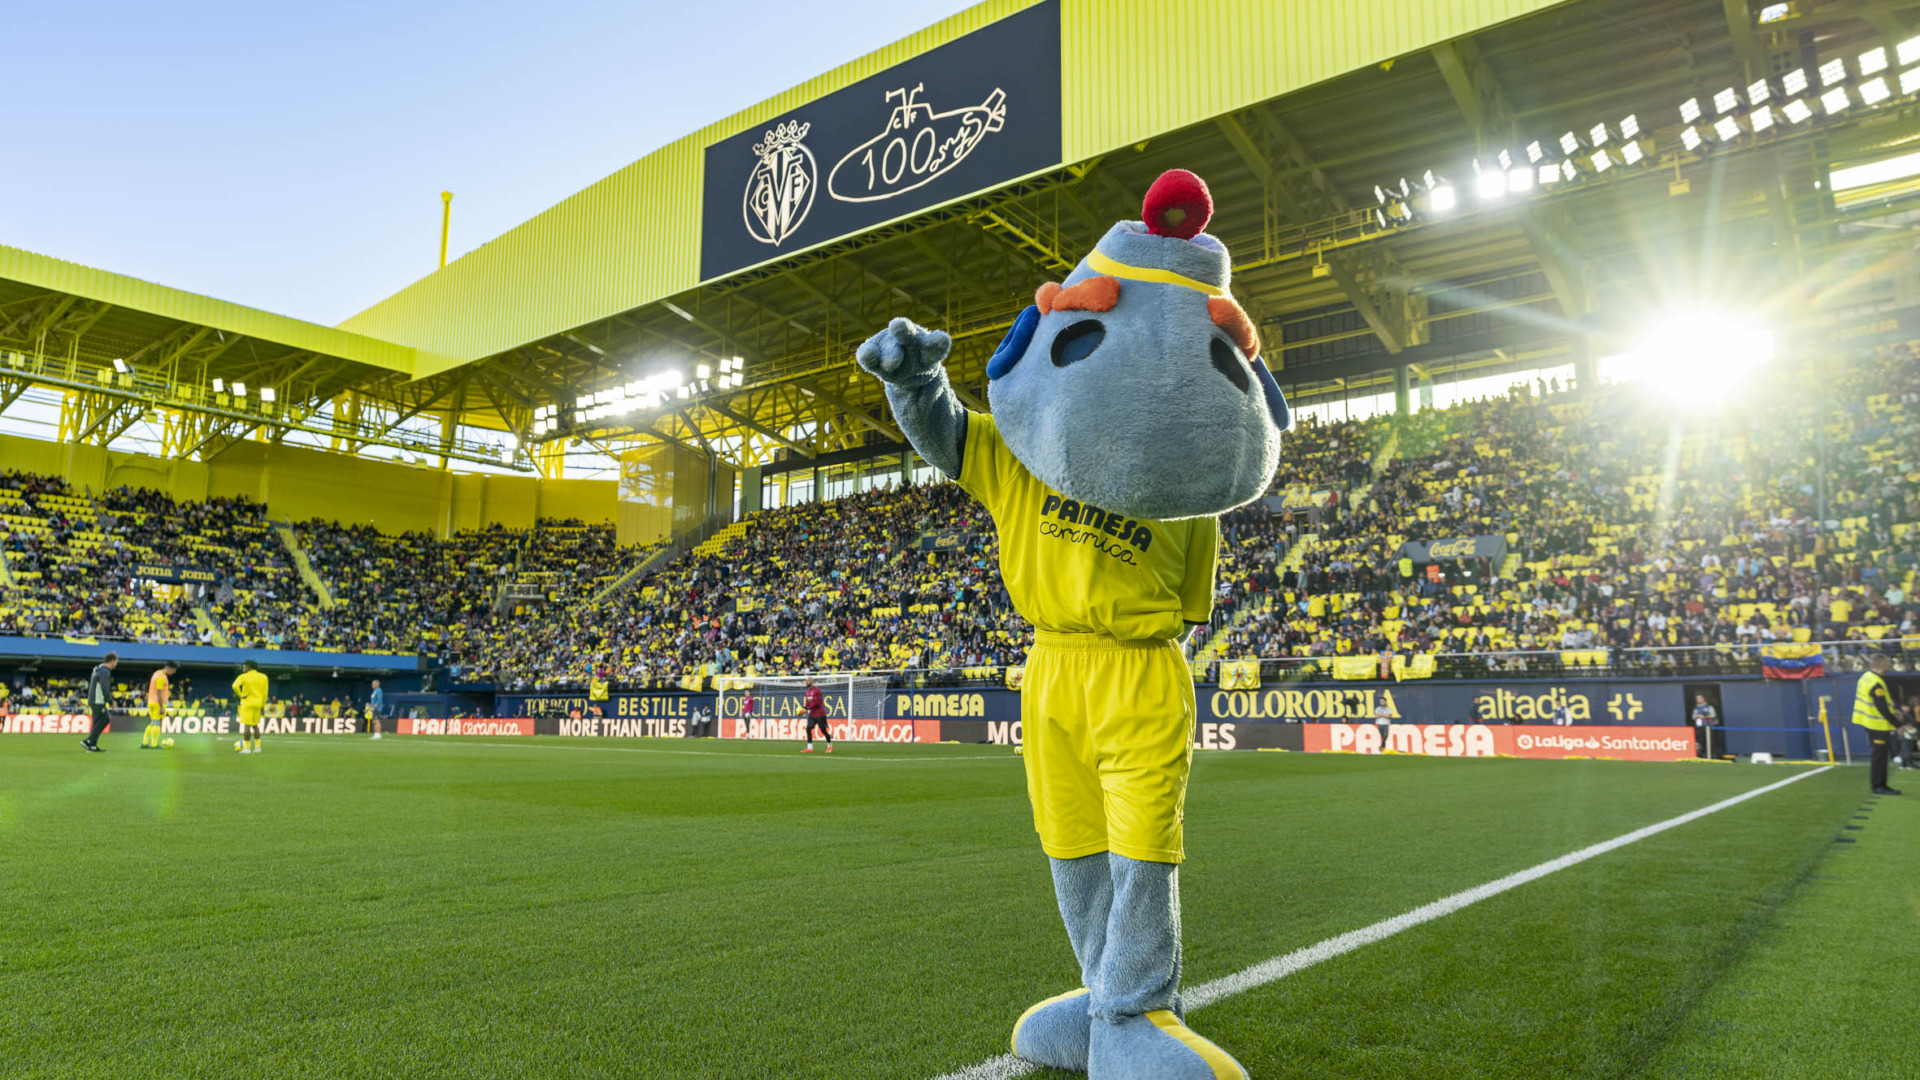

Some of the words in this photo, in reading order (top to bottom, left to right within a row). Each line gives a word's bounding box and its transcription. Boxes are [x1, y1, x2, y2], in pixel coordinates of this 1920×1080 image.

[861, 126, 936, 191] 100
[1040, 494, 1153, 553] PAMESA
[618, 697, 688, 716] BESTILE
[715, 696, 847, 717] PORCELANSA
[897, 693, 985, 717] PAMESA
[1211, 689, 1402, 718] COLOROBBIA
[1479, 687, 1591, 720] altadia
[161, 716, 230, 734] MORE
[302, 717, 357, 734] TILES
[412, 718, 462, 736] PASA
[559, 718, 598, 737] MORE
[602, 718, 642, 737] THAN
[646, 718, 686, 738] TILES
[735, 718, 808, 739] PAMESA
[1330, 723, 1495, 757] PAMESA
[1535, 735, 1584, 751] LaLiga
[1602, 736, 1689, 751] Santander
